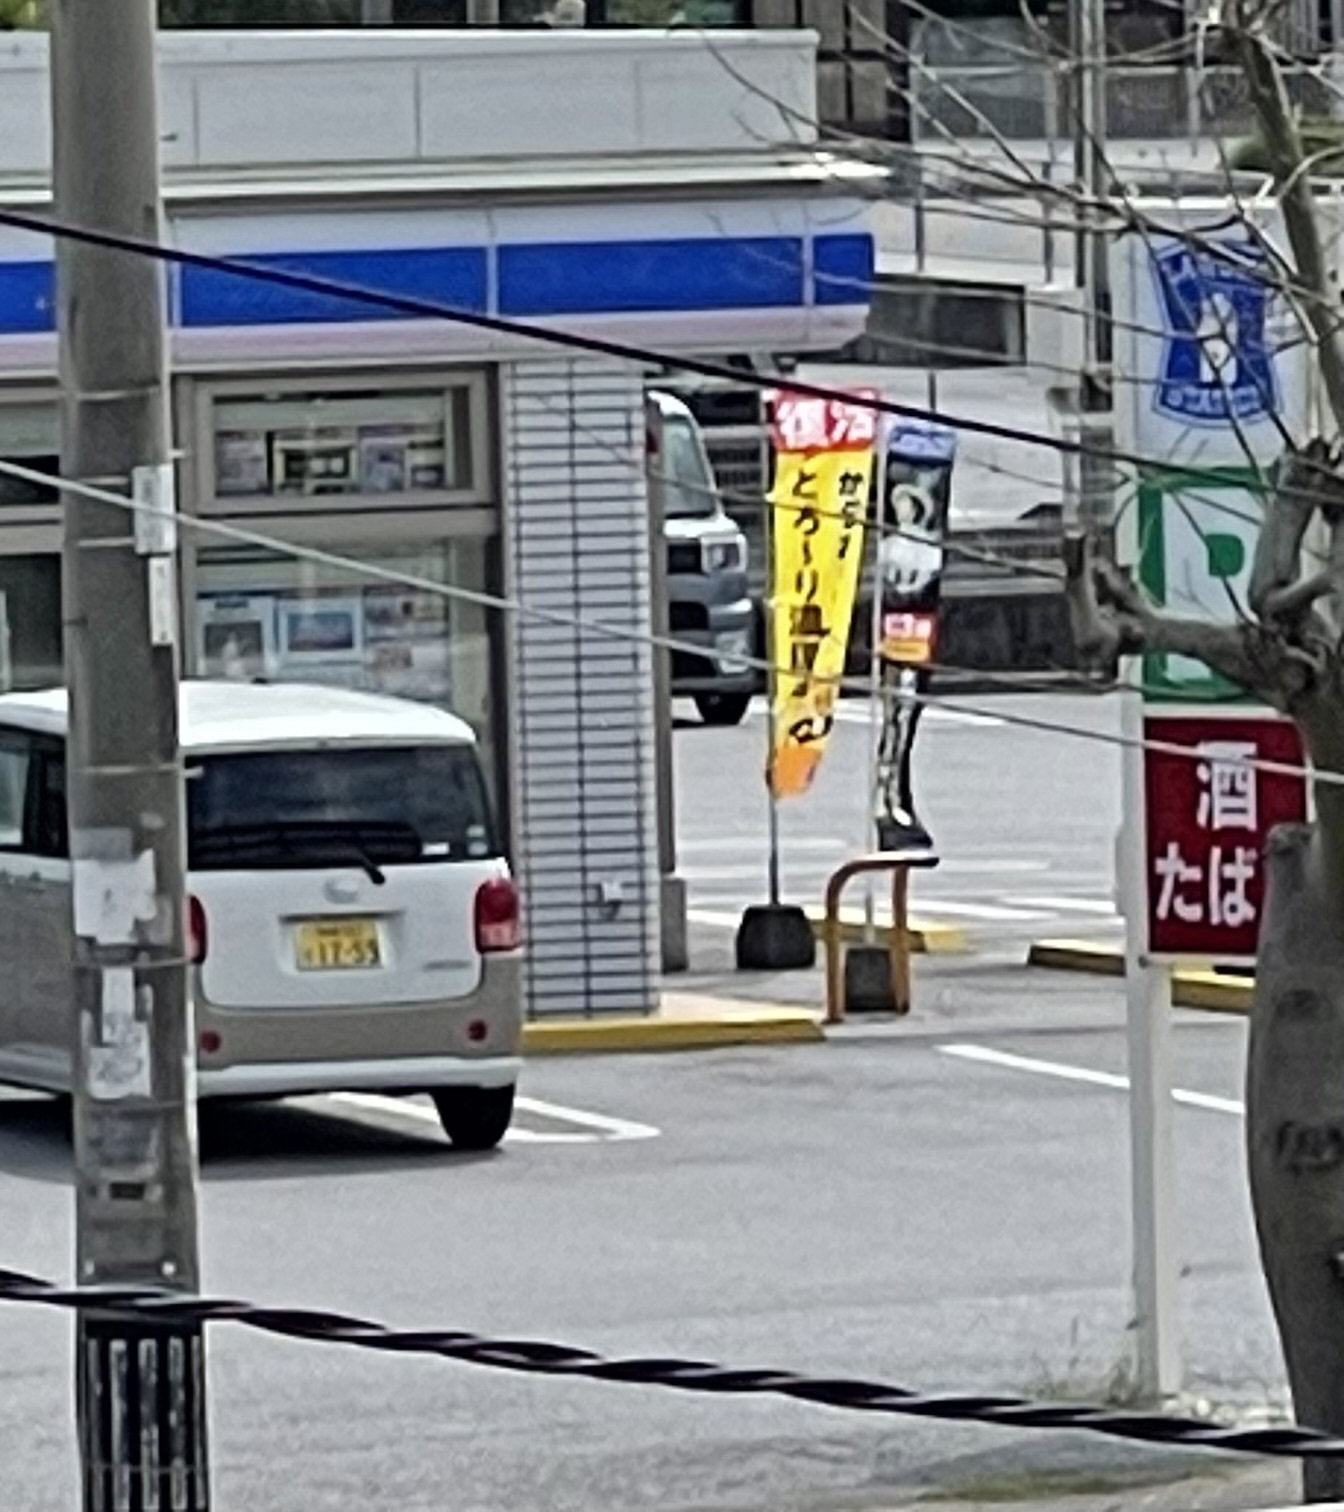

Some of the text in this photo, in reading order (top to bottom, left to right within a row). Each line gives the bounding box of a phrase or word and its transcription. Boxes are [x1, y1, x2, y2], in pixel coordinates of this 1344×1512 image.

[776, 399, 875, 448] 復活
[1196, 741, 1258, 831] 酒
[1155, 842, 1257, 926] たば
